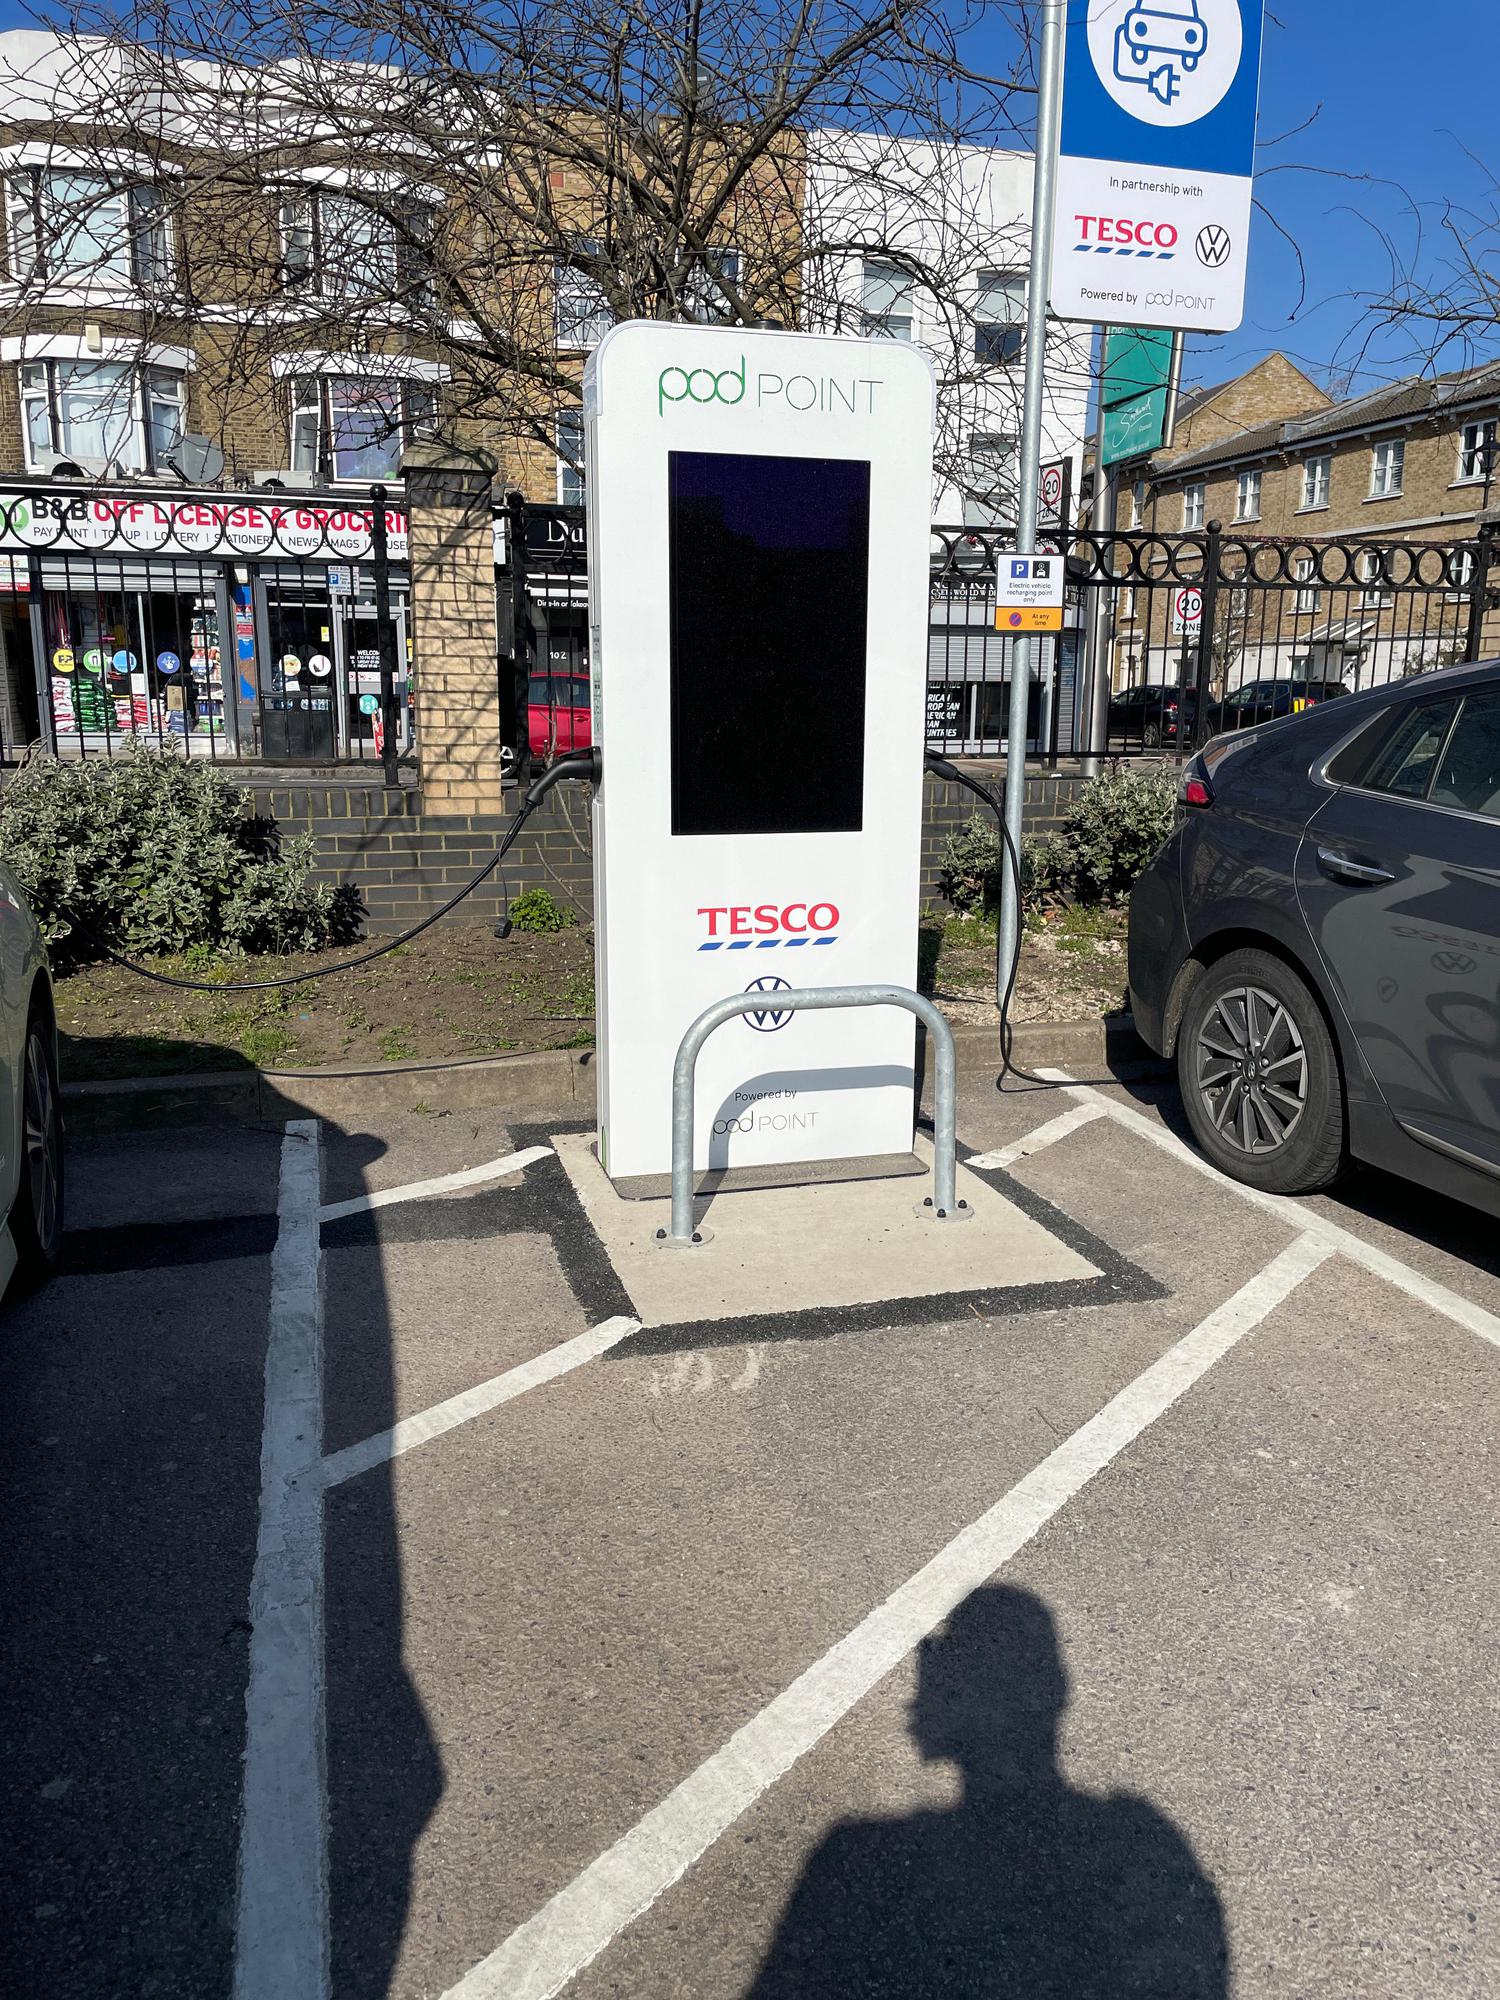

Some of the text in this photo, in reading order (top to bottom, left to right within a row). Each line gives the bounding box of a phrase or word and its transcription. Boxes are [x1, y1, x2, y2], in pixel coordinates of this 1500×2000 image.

[1109, 176, 1203, 197] In partnership with
[1074, 215, 1178, 248] TESCO
[1080, 287, 1216, 311] Powered by pod POINT
[658, 353, 884, 418] pod POINT
[1045, 479, 1058, 495] 20
[32, 498, 88, 520] B&B
[94, 500, 145, 523] OFF
[154, 502, 264, 528] LICENSE
[270, 507, 288, 529] &
[33, 527, 53, 537] PAY
[288, 537, 319, 548] NEWS
[328, 539, 360, 549] MAGS
[1182, 598, 1201, 611] 20
[1176, 623, 1201, 632] ZONE
[550, 651, 567, 660] 102
[697, 902, 840, 936] TESCO
[735, 1088, 798, 1101] Powered by
[712, 1110, 820, 1142] pod POINT
